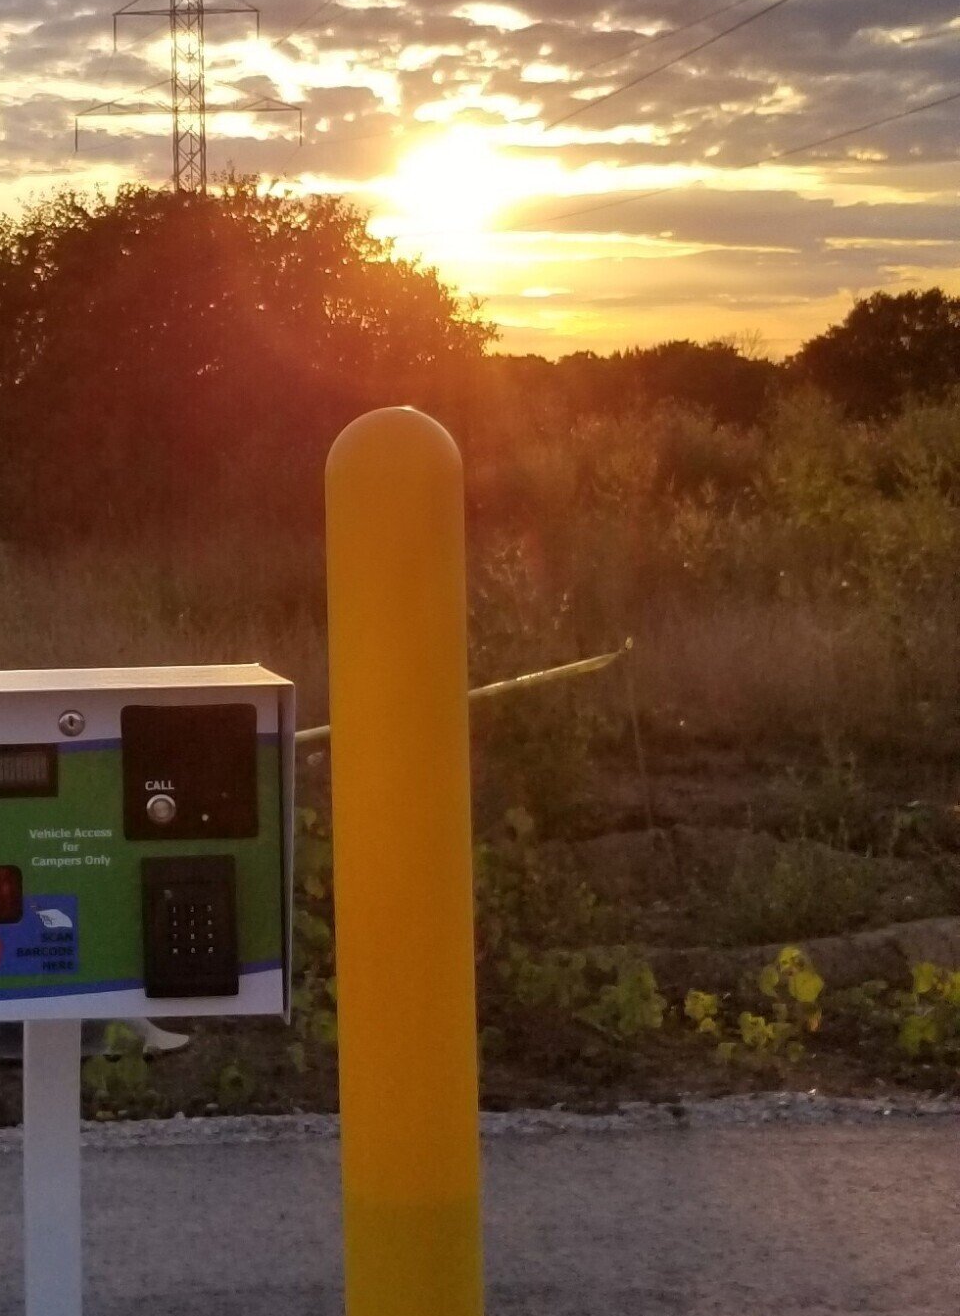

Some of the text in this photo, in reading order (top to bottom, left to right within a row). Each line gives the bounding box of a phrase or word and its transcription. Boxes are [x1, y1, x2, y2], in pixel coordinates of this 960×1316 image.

[145, 779, 175, 791] CALL
[29, 827, 112, 839] Vehicle Access
[62, 841, 80, 852] for
[31, 854, 111, 868] Campers Only
[41, 931, 74, 943] SCAN
[16, 946, 74, 958] BARCODE
[42, 960, 74, 971] HERE
